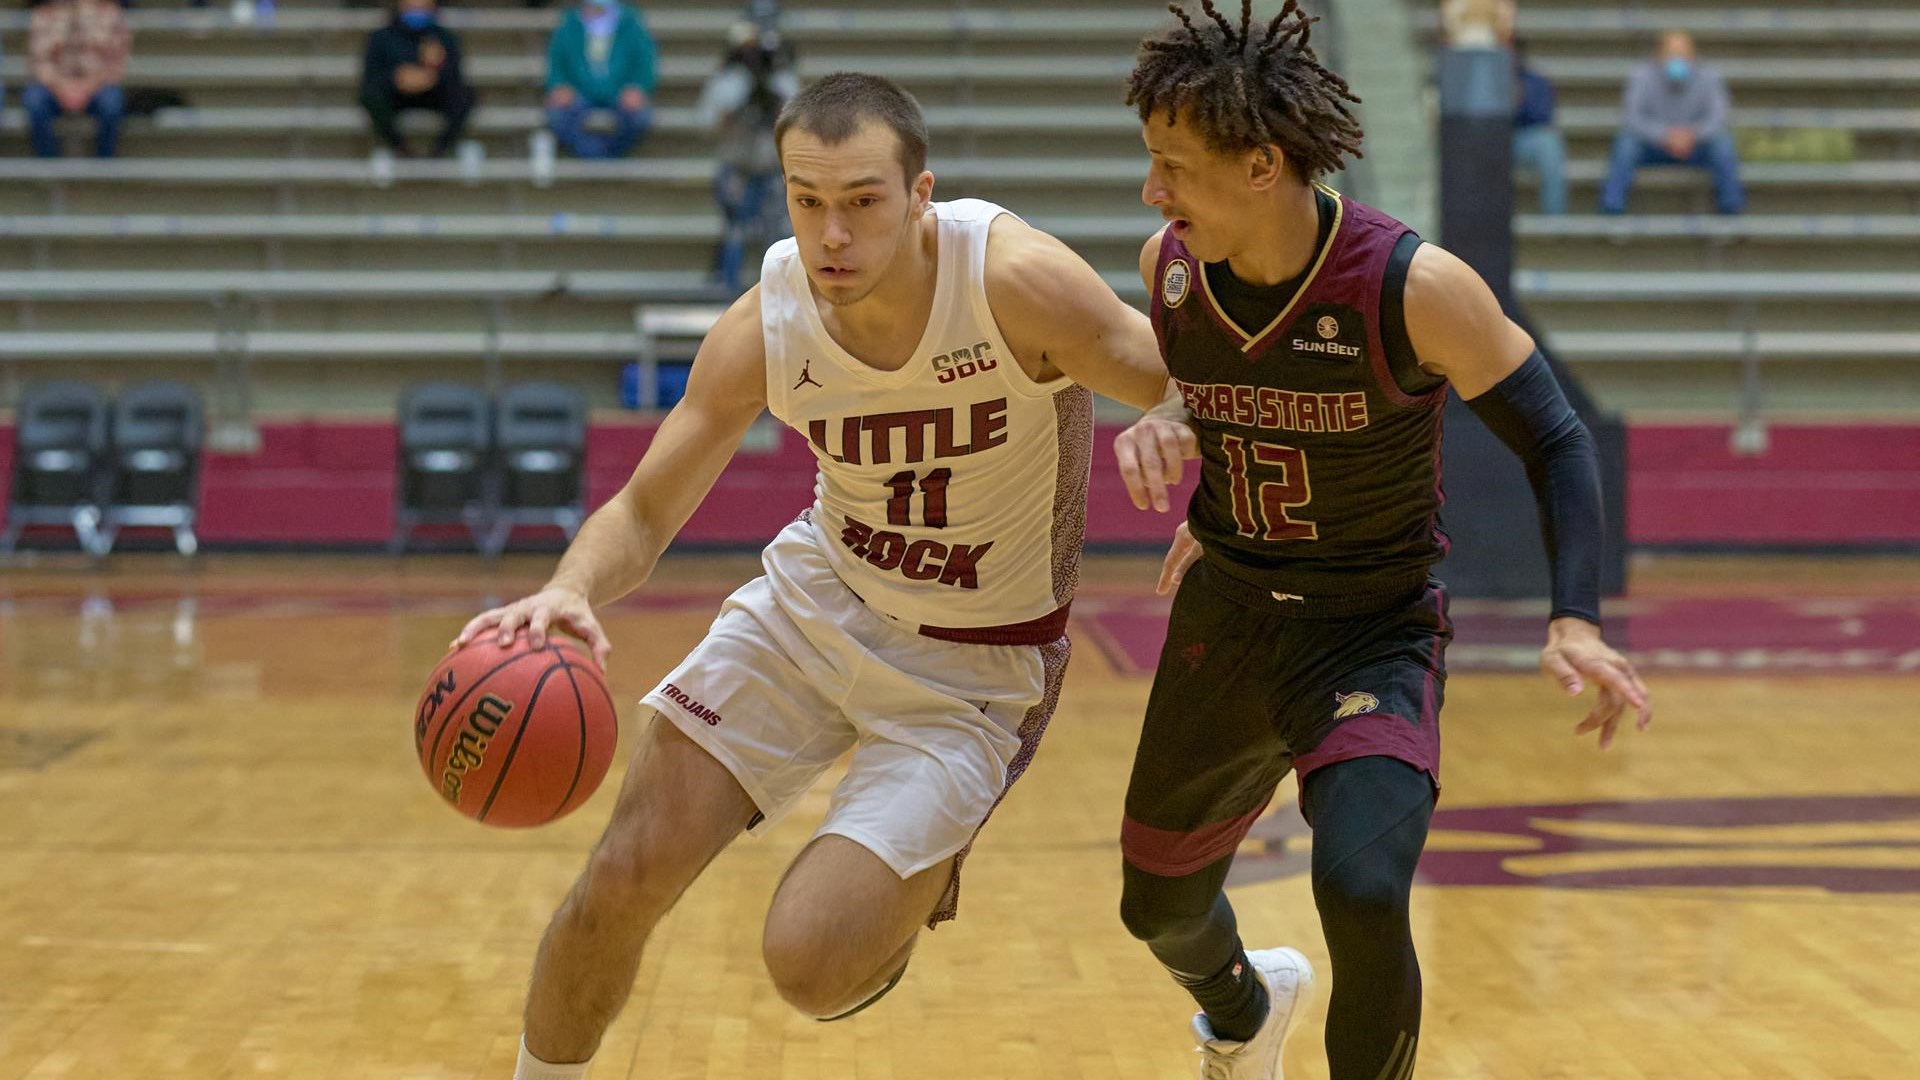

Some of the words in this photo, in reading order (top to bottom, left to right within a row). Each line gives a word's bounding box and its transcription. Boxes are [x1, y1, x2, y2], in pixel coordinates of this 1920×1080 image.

[931, 341, 998, 384] SBC
[808, 397, 1008, 465] LITTLE
[1175, 378, 1257, 427] EXAS
[1257, 387, 1369, 432] STATE
[883, 467, 952, 529] 11
[1222, 433, 1318, 540] 12
[841, 514, 995, 589] ROCK
[660, 683, 722, 726] TROJANS
